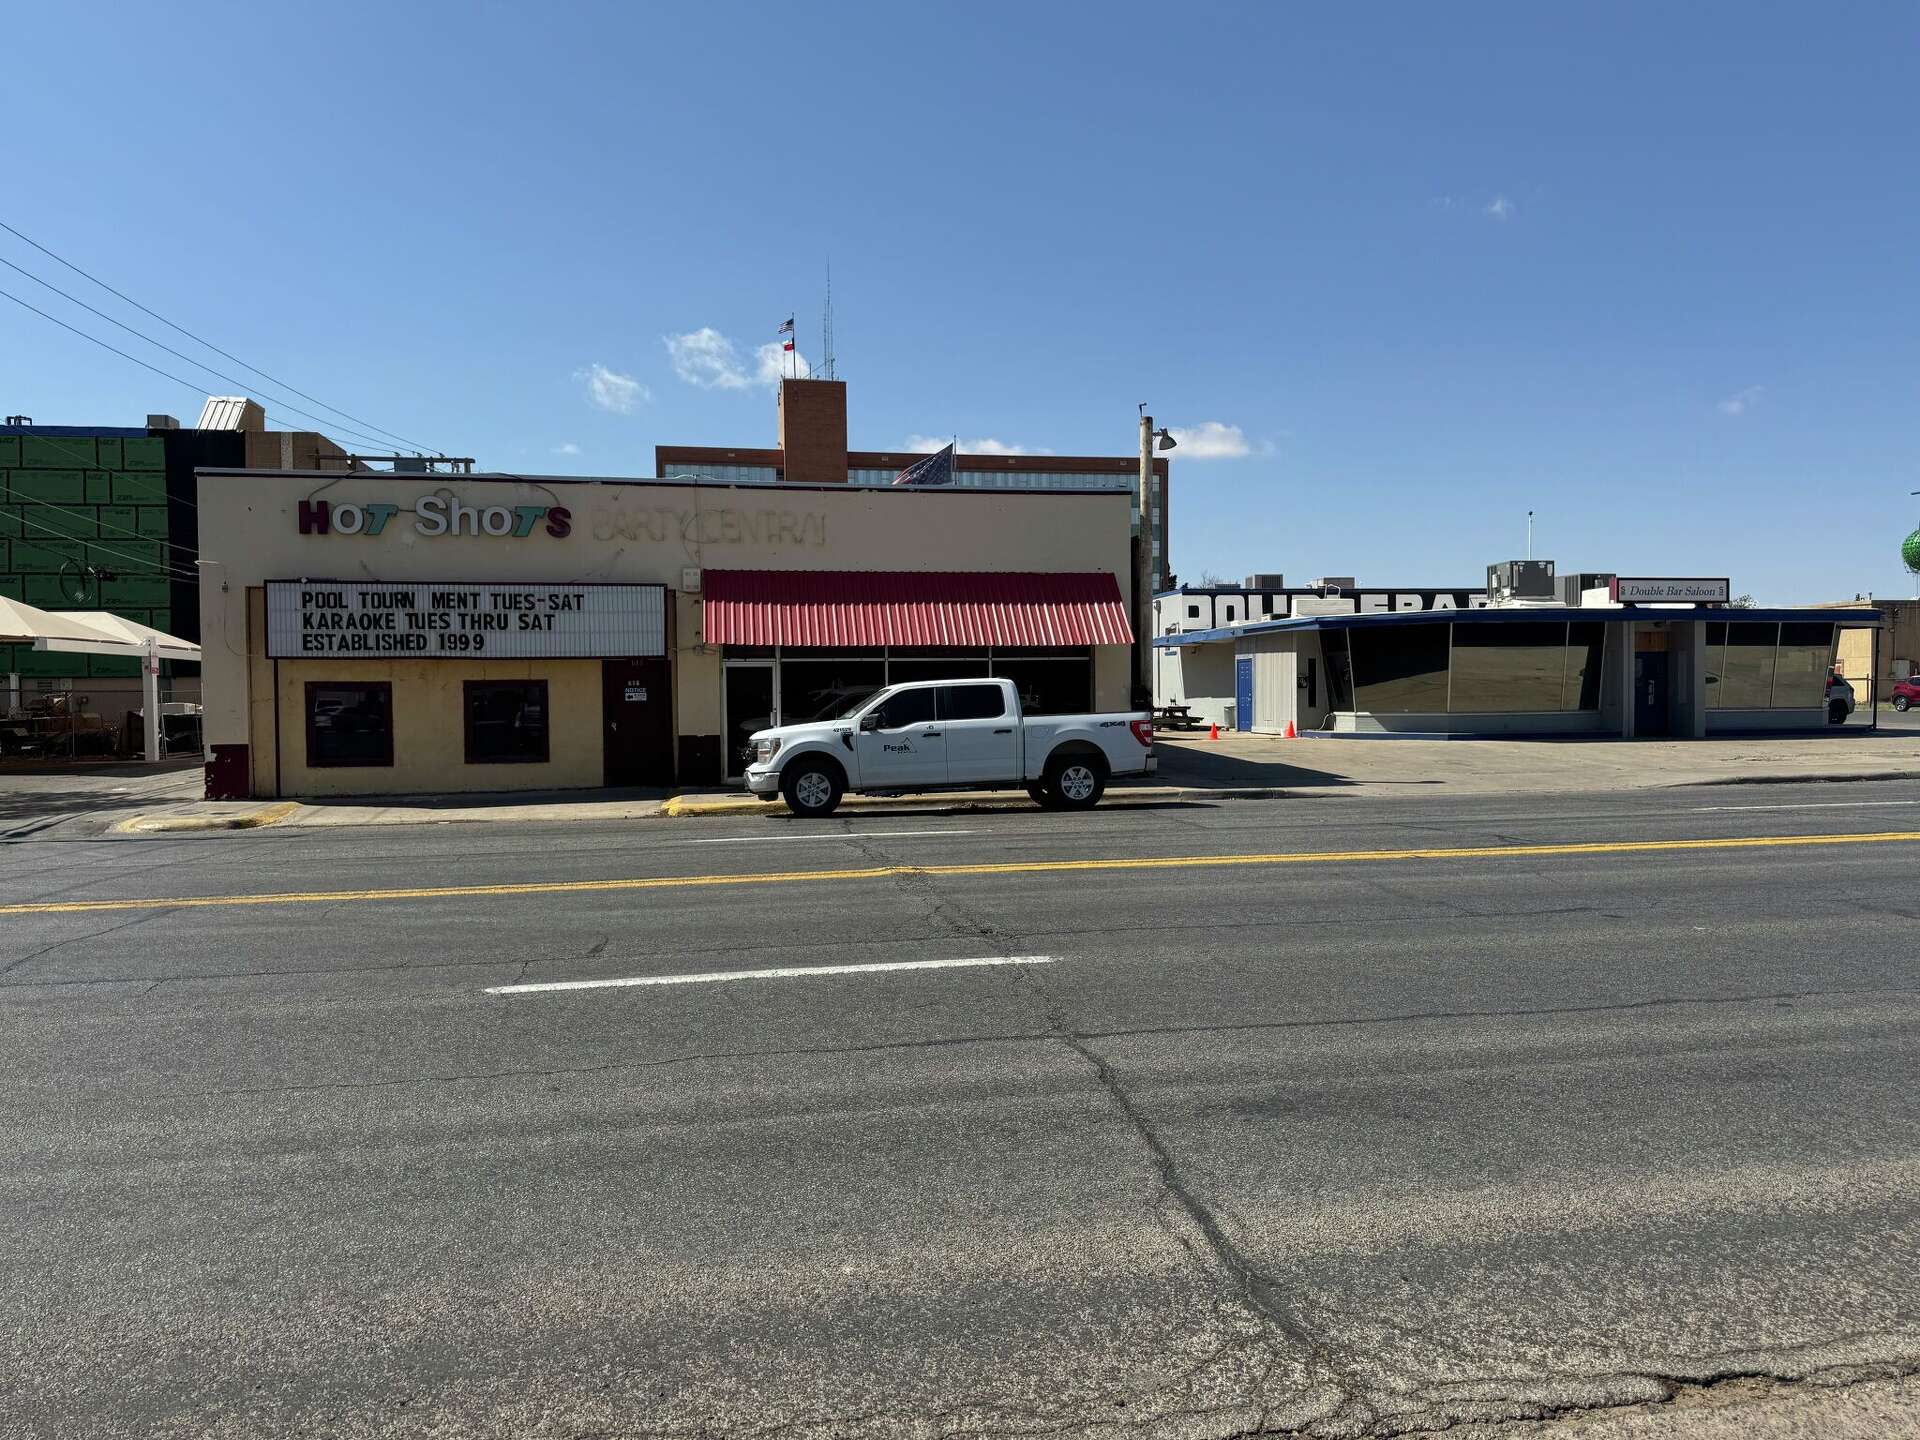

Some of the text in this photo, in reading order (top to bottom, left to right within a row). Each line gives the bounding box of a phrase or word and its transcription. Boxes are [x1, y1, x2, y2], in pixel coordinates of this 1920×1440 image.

[1630, 585, 1716, 596] Double Bar Saloon
[302, 592, 584, 611] POOL TOURN MENT TUES-SAT
[303, 612, 555, 630] KARAOKE TUES THRU SAT
[303, 633, 485, 651] ESTABLISHED 1999
[883, 744, 911, 752] Peak
